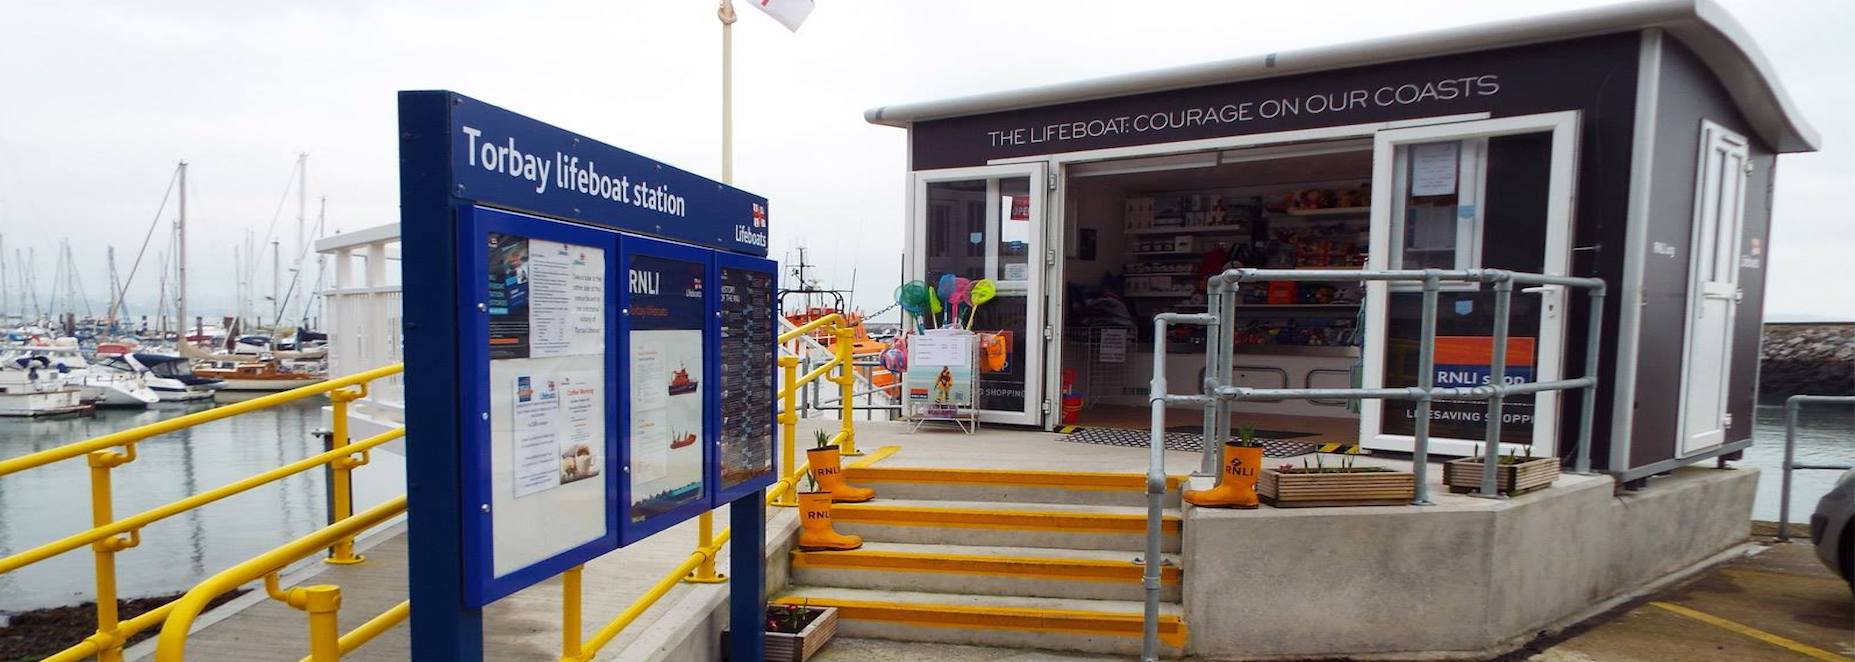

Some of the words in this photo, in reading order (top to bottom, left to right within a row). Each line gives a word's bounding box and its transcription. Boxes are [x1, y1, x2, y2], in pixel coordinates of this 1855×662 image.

[988, 128, 1026, 147] THE
[1030, 116, 1130, 144] LIFEBOAT:
[1133, 102, 1253, 132] COURAGE
[1258, 97, 1299, 119] ON
[1305, 89, 1368, 114] OUR
[1374, 74, 1500, 106] COASTS
[463, 126, 551, 194] Torbay
[556, 151, 630, 203] lifeboat
[633, 184, 685, 218] station
[1012, 206, 1029, 216] OPE
[735, 223, 767, 249] Lifeboats
[629, 269, 660, 295] RNLI
[1437, 370, 1477, 384] RNLI
[1482, 375, 1525, 385] sop
[1406, 409, 1480, 422] LIESAVING
[817, 466, 839, 475] RNL
[1225, 465, 1254, 476] RNLI
[808, 511, 830, 520] RNL
